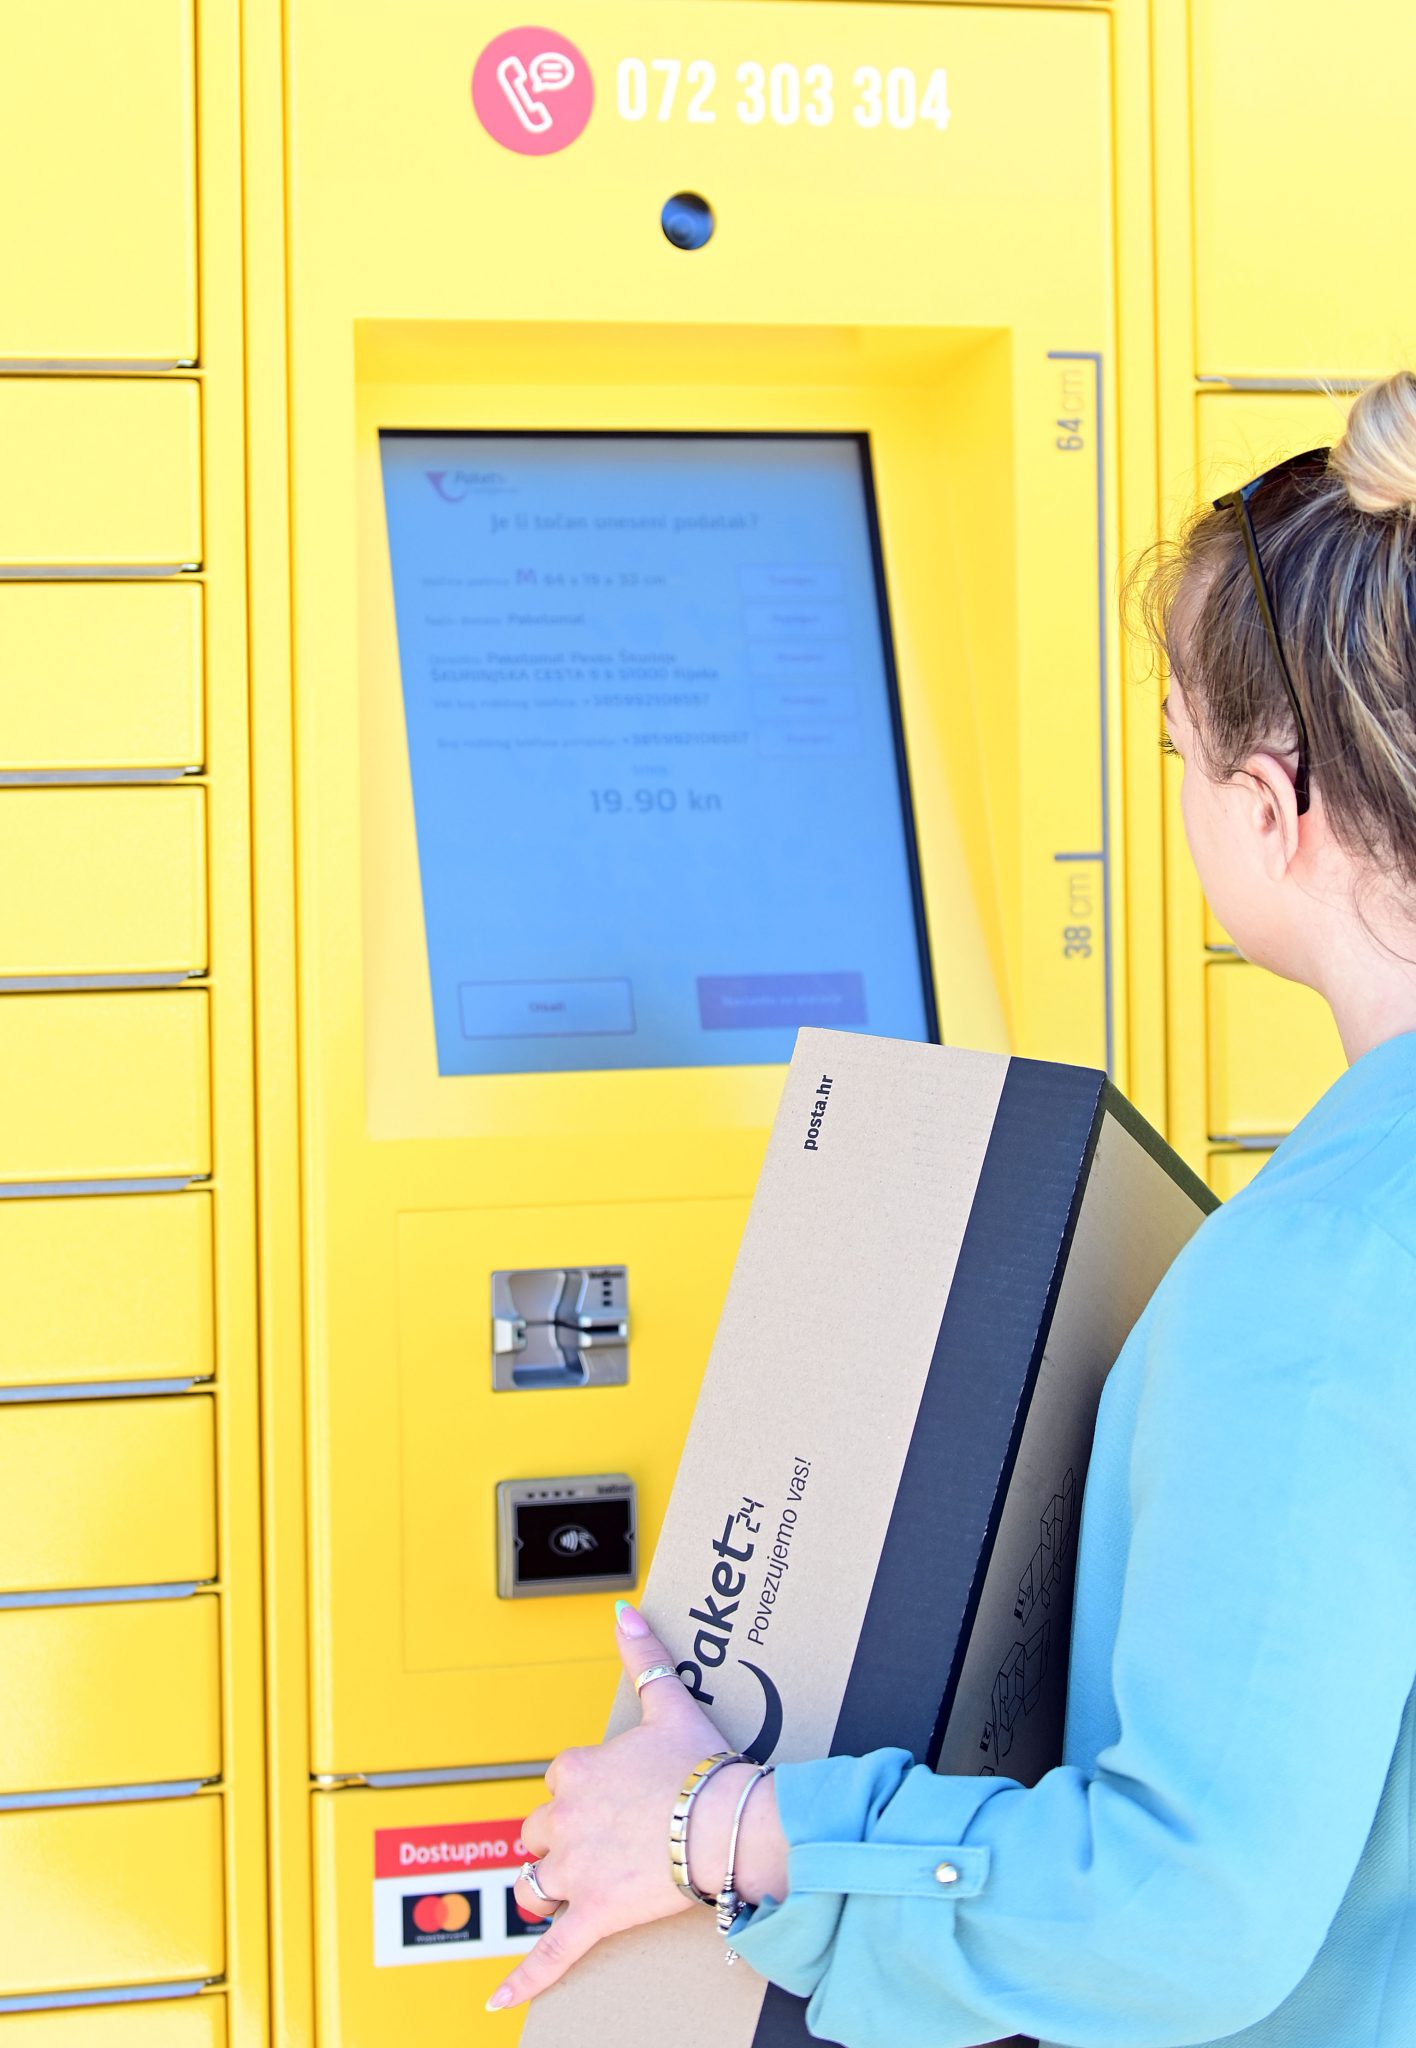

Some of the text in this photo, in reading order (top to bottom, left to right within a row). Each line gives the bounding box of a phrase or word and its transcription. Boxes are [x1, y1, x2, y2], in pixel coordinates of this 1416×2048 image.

[616, 56, 951, 131] 072 303 304
[1056, 367, 1085, 451] 64 cm
[515, 567, 538, 585] M
[589, 786, 723, 814] 19.90 kn
[1063, 872, 1094, 960] 38 cm
[803, 1074, 834, 1151] posta.hr
[747, 1456, 812, 1647] Povezujemo vas!
[399, 1838, 509, 1866] Dostupno
